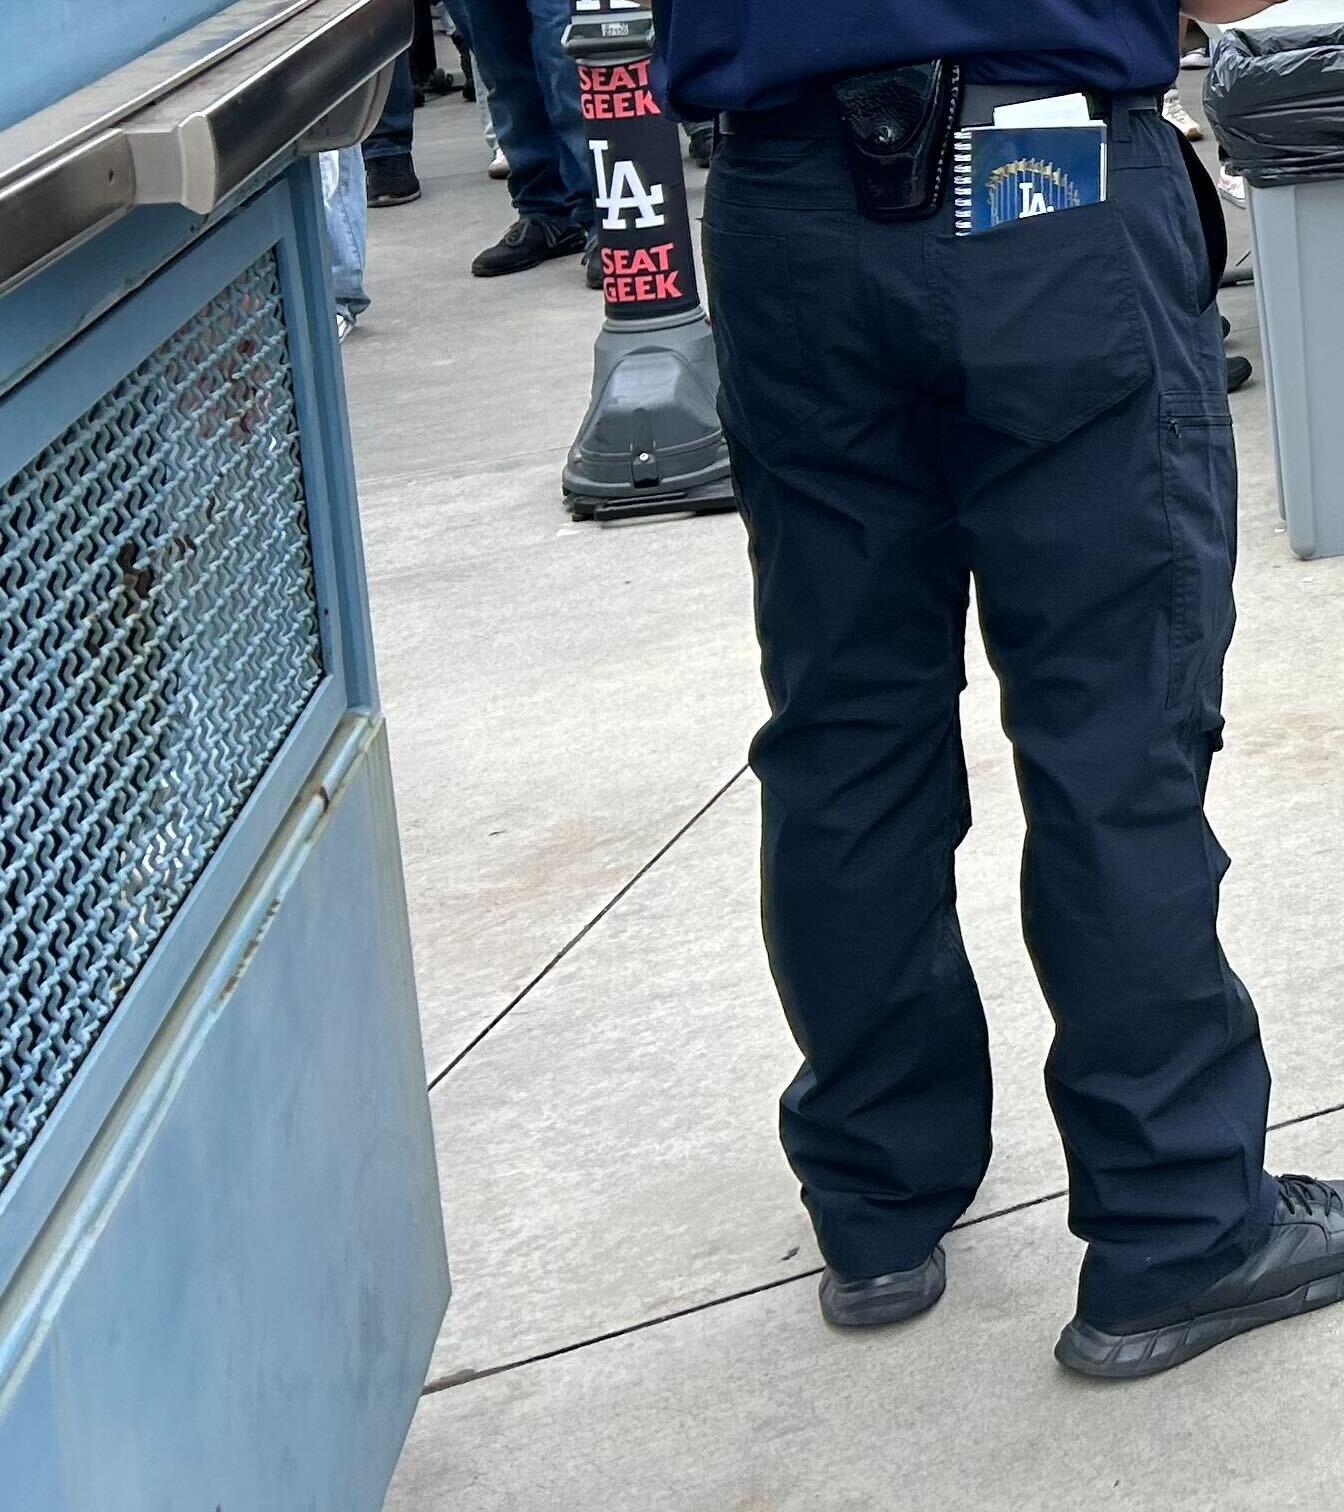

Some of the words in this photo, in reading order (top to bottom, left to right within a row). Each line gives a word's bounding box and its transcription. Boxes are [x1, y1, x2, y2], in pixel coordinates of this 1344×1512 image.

[577, 58, 651, 92] SEAT
[581, 89, 661, 119] GEEK
[588, 139, 664, 229] LA
[601, 242, 674, 275] SEAT
[603, 270, 682, 303] GEEK
